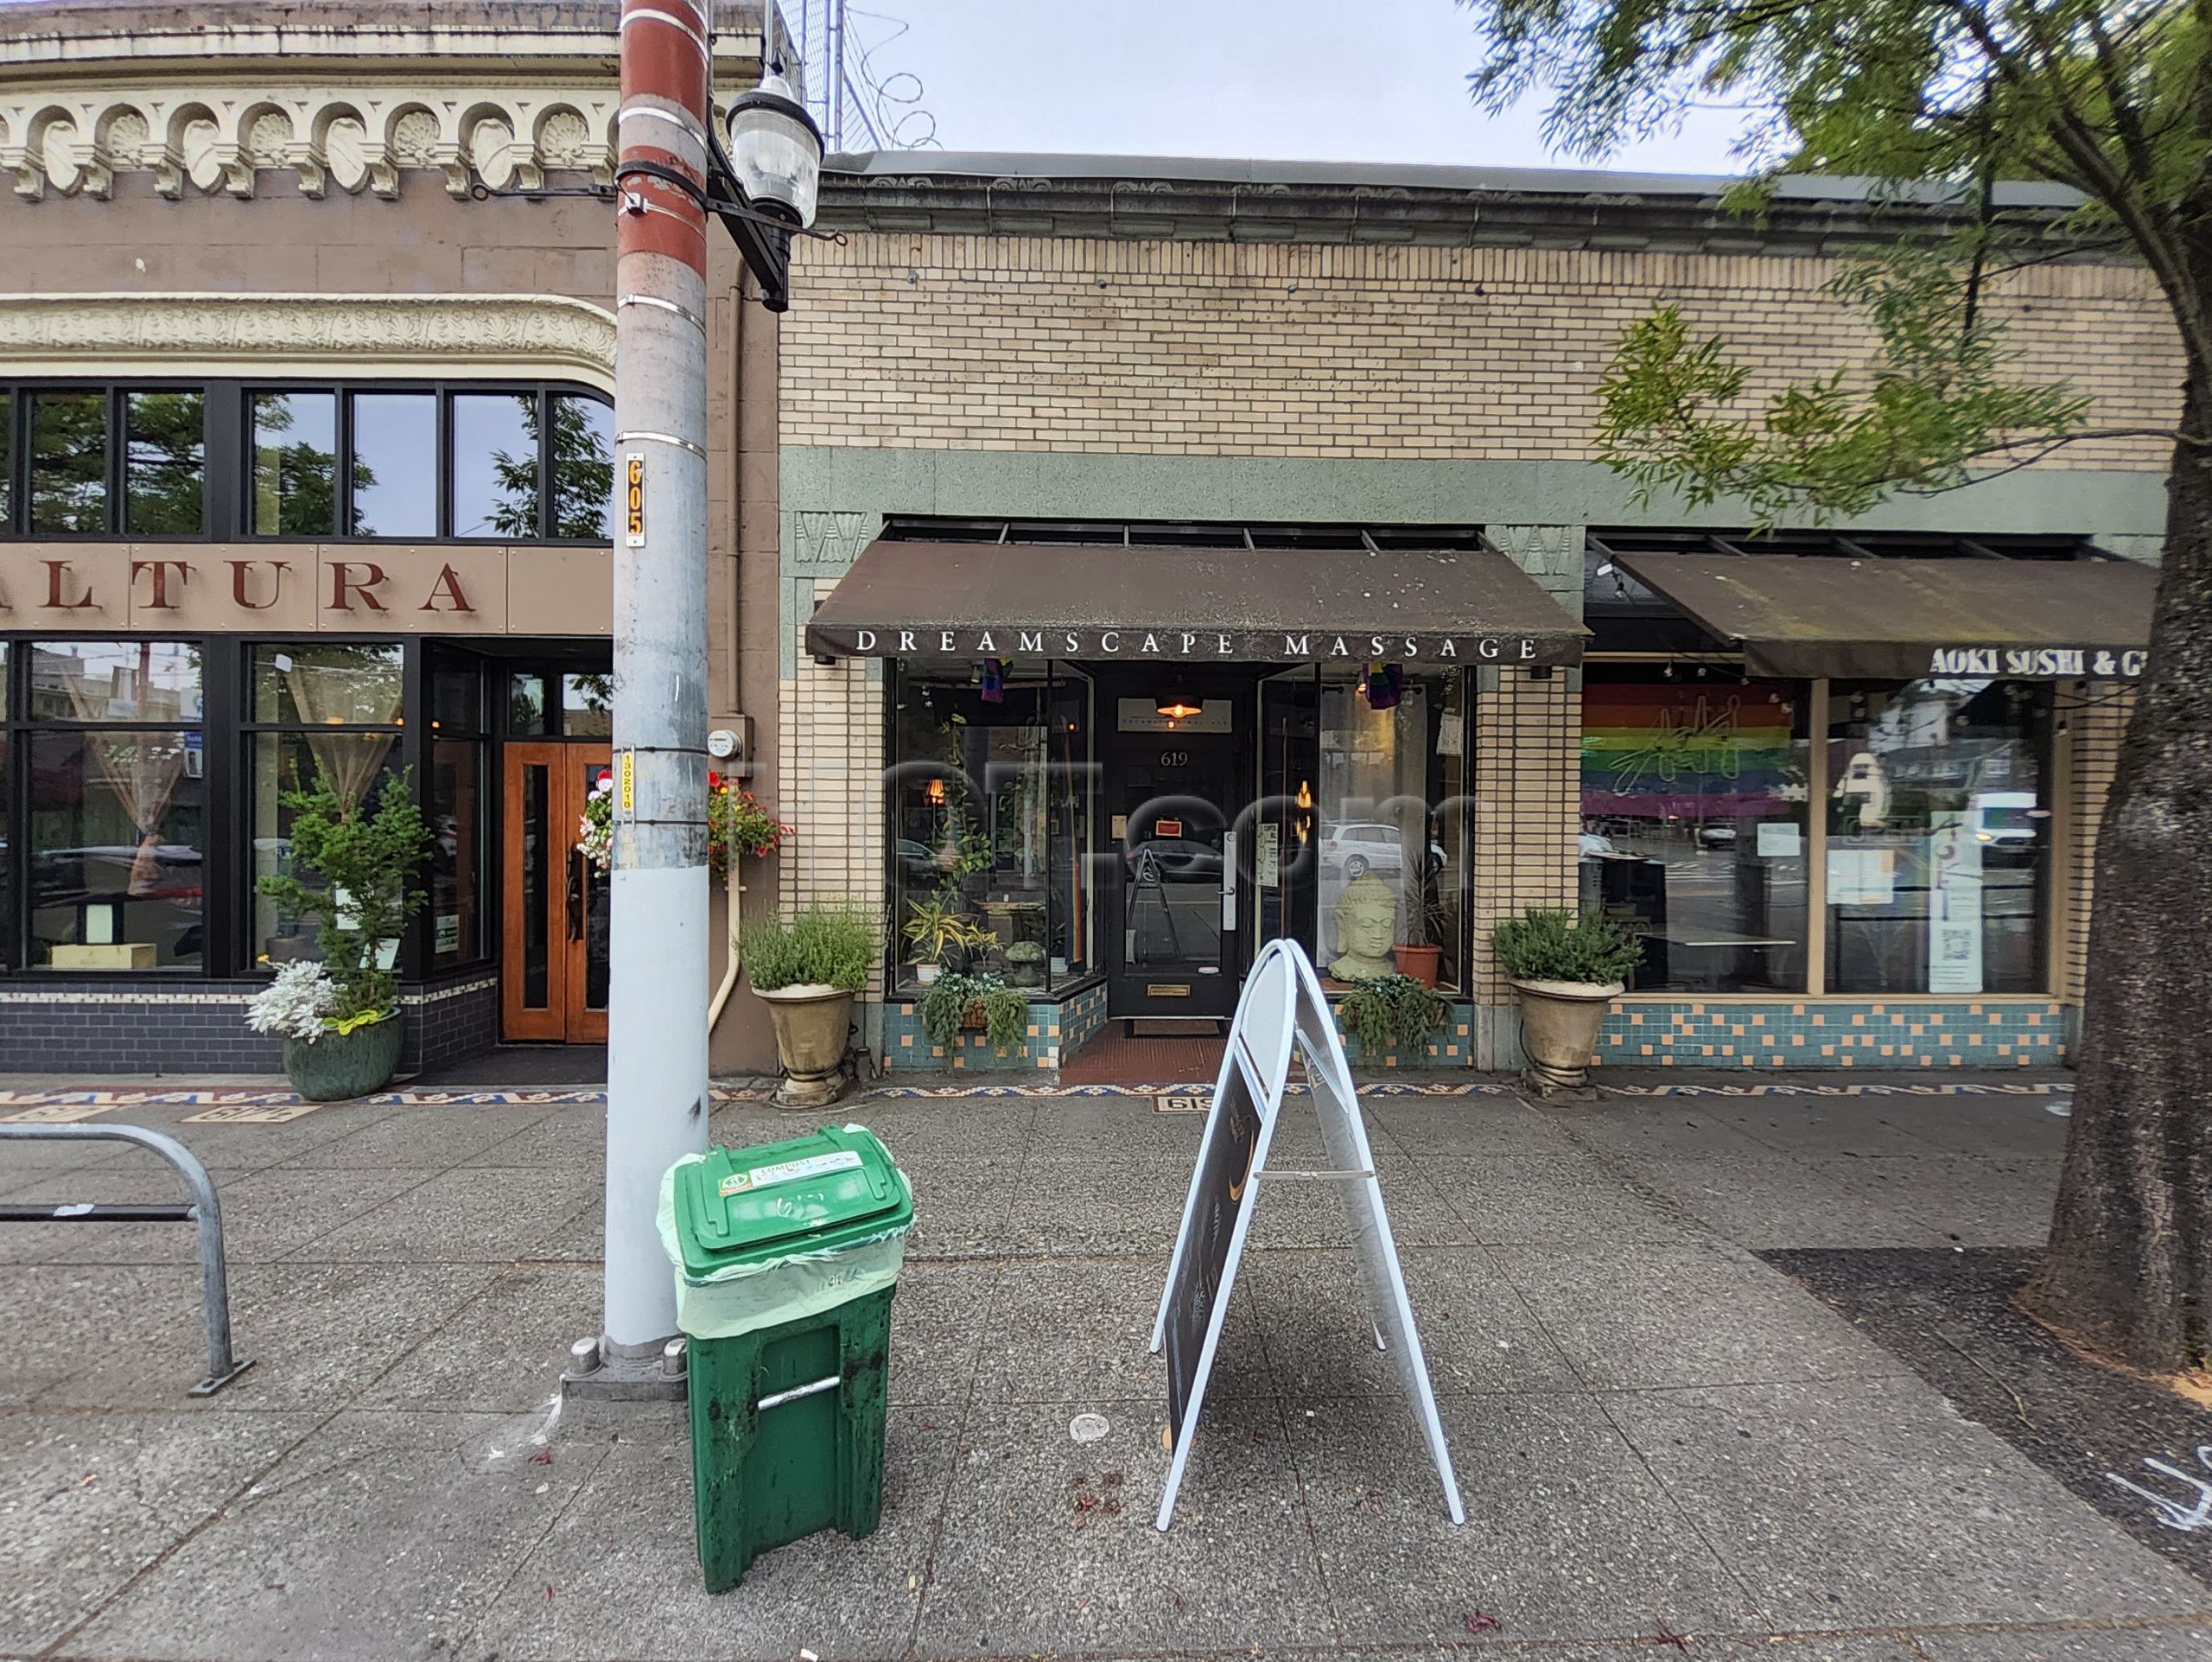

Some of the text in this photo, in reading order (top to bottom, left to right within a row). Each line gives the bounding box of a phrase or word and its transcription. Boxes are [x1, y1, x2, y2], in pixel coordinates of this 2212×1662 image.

[629, 461, 642, 535] 605
[0, 559, 477, 612] LTURA
[855, 629, 1537, 659] DREAMSCAPE MASSAGE
[1929, 647, 2000, 674] AOKI
[2005, 648, 2087, 676] SUSHI
[2092, 650, 2116, 676] &
[1160, 752, 1188, 767] 619
